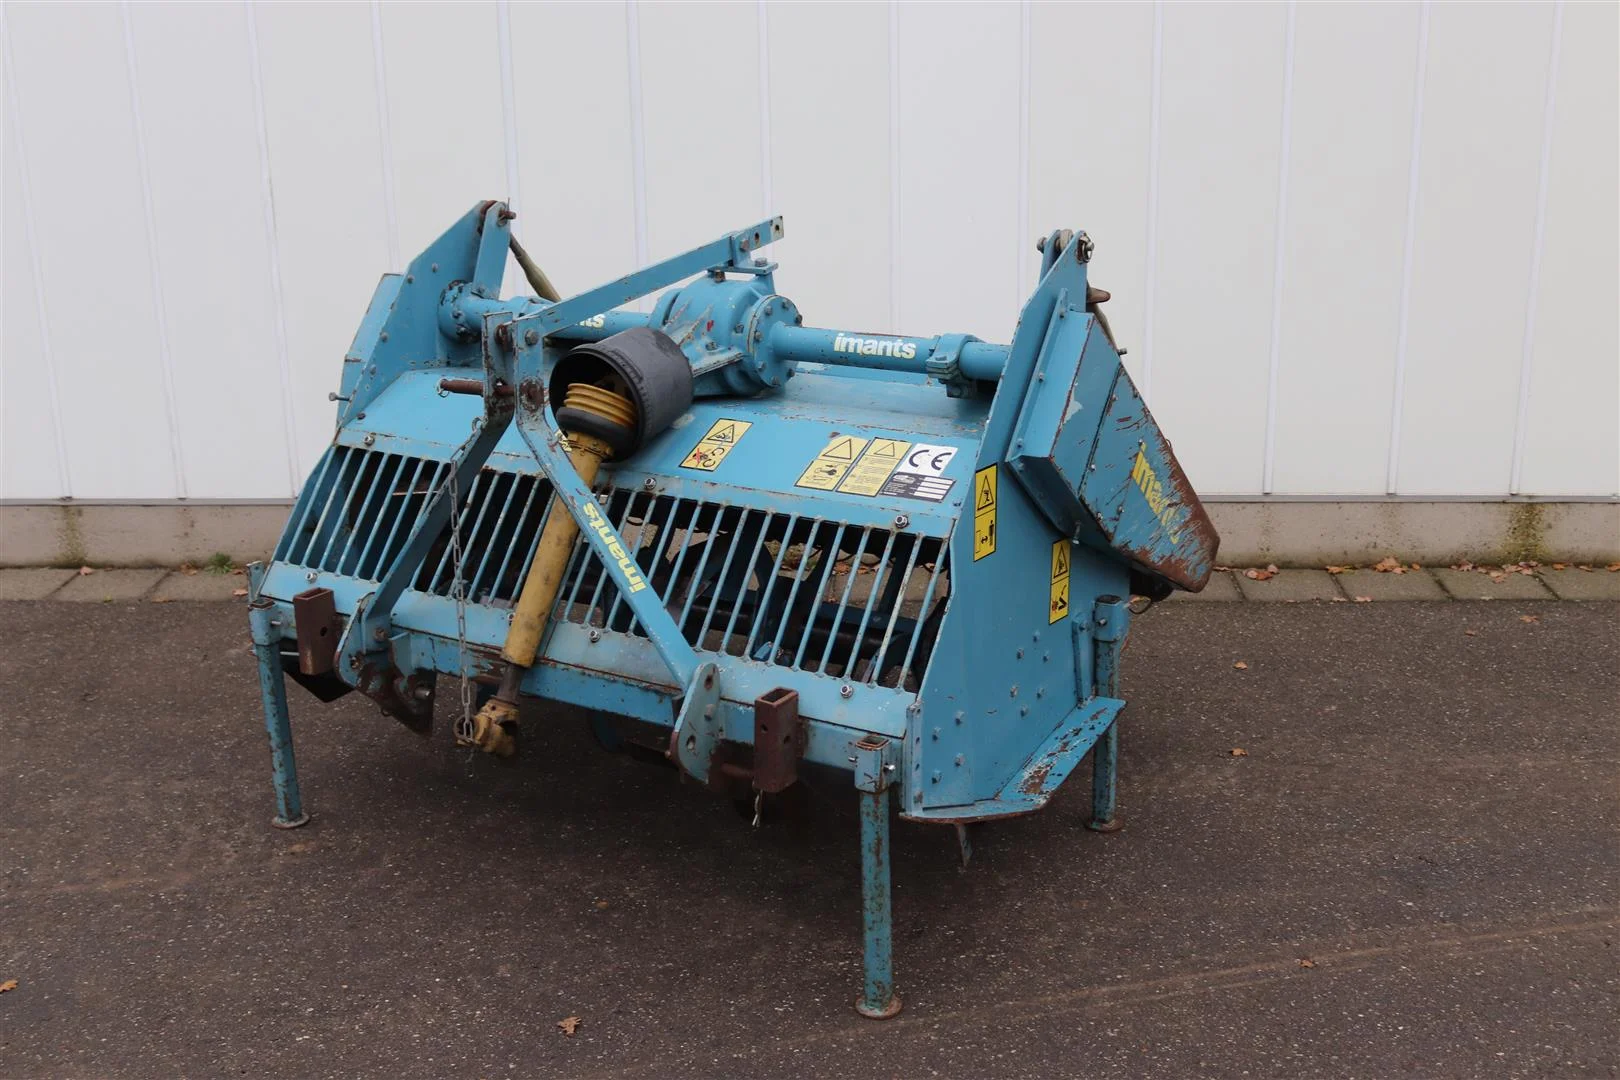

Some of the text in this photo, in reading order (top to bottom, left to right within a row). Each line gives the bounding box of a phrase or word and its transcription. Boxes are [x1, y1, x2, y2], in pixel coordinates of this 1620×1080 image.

[834, 332, 916, 359] imants
[908, 449, 952, 471] CE
[583, 502, 647, 593] imants
